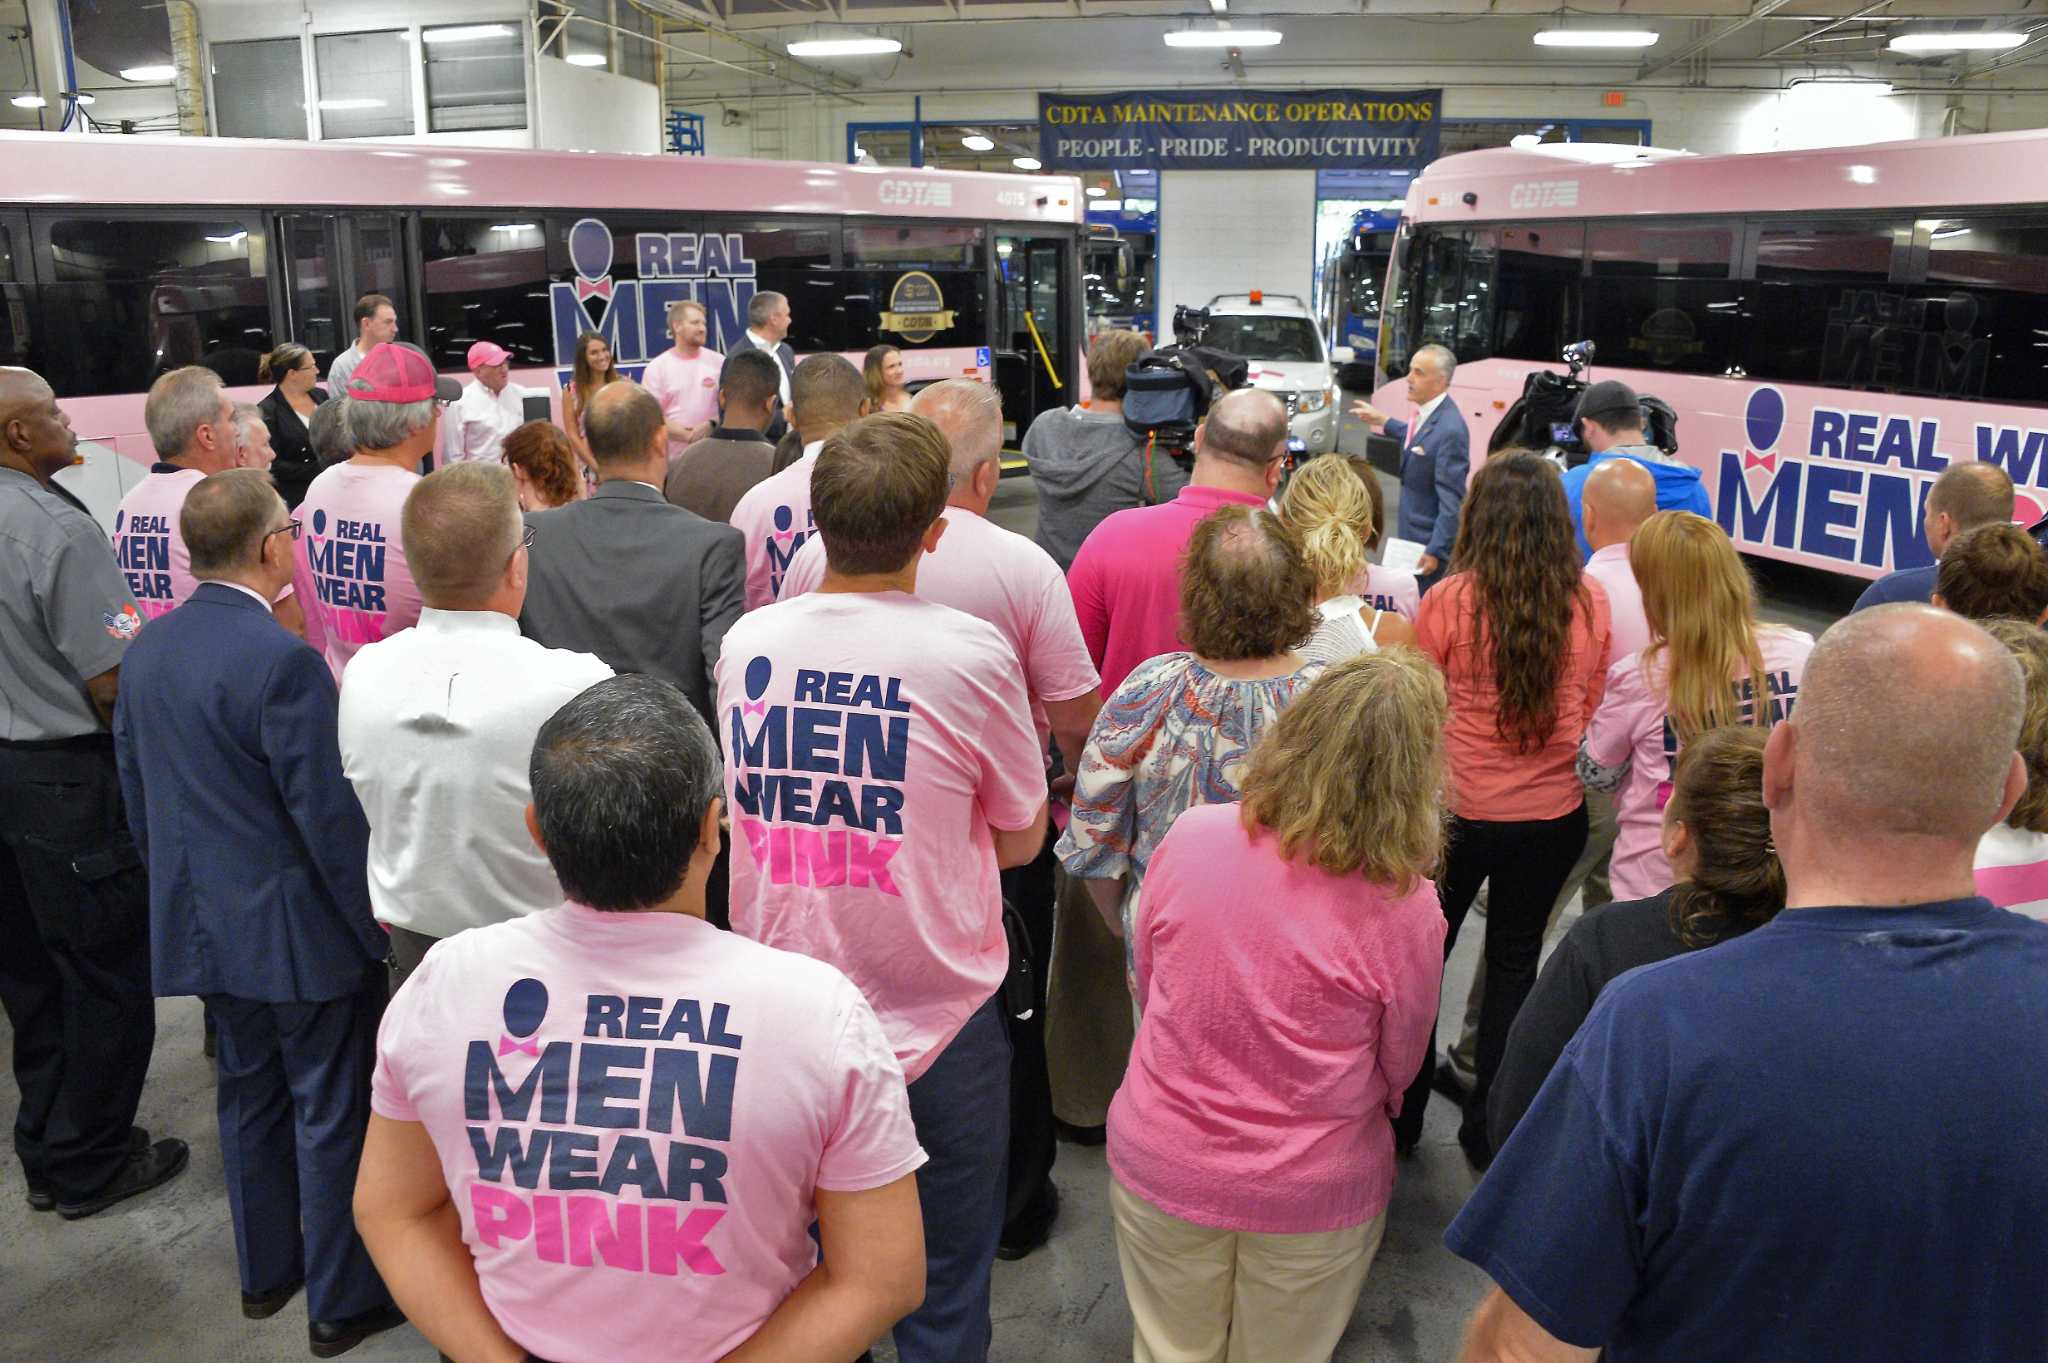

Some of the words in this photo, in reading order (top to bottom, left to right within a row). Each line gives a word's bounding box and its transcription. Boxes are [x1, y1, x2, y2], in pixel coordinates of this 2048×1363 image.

[1045, 104, 1107, 124] CDTA
[1113, 102, 1280, 123] MAINTENANCE
[1285, 102, 1433, 122] OPERATIONS
[1057, 138, 1142, 158] PEOPLE
[1160, 138, 1229, 157] PRIDE
[1248, 137, 1421, 157] PRODUCTIVITY
[635, 233, 756, 278] REAL
[549, 278, 758, 366] MEN
[1809, 408, 1950, 473] REAL
[130, 515, 171, 533] REAL
[336, 519, 386, 543] REAL
[1716, 452, 1938, 572] MEN
[307, 535, 386, 582] MEN
[124, 572, 174, 599] EAR
[313, 574, 387, 612] WEAR
[1360, 594, 1398, 612] EAL
[794, 669, 911, 713] REAL
[732, 706, 910, 782] MEN
[734, 773, 905, 835] WEAR
[583, 994, 743, 1050] REAL
[464, 1040, 739, 1142] MEN
[466, 1126, 729, 1204] WEAR
[470, 1183, 728, 1276] PINK
